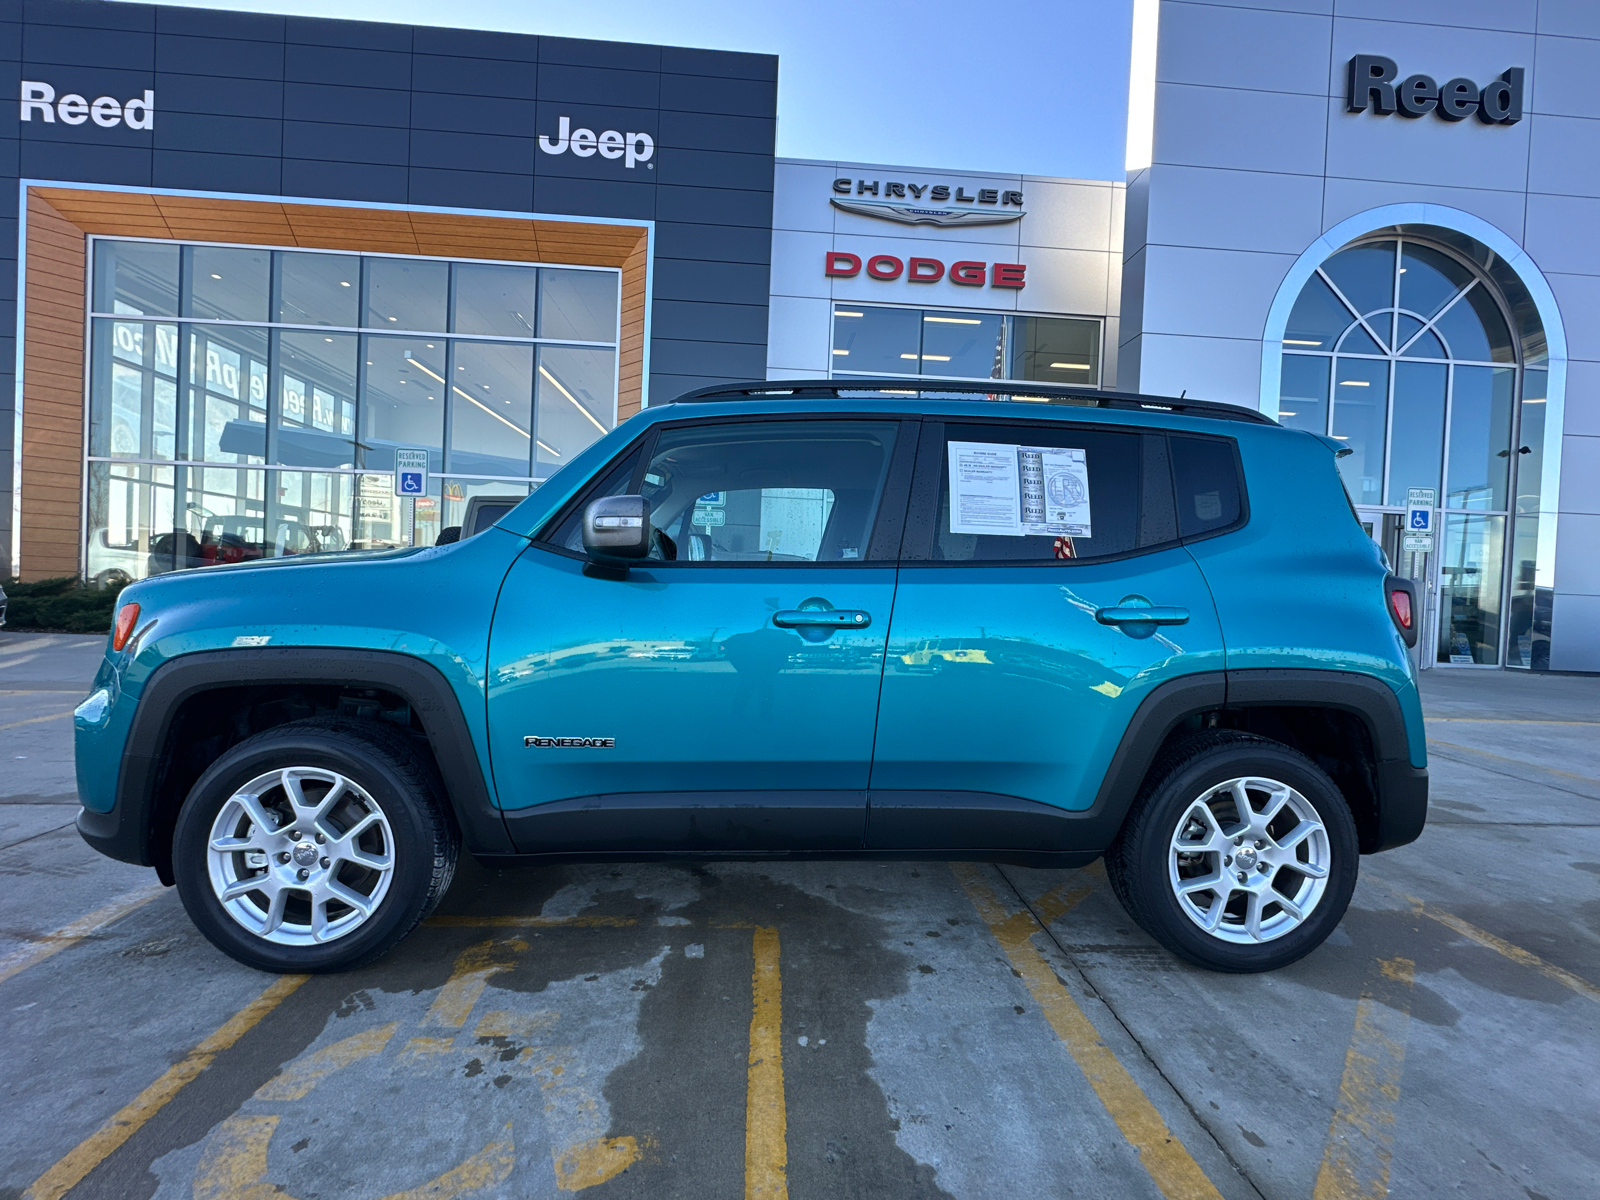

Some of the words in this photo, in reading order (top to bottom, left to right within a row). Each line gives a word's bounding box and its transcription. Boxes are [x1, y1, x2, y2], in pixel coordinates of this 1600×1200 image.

[1347, 53, 1525, 126] Reed
[20, 80, 155, 131] Reed
[539, 116, 655, 169] Jeep
[833, 178, 1024, 204] CHRYSLER
[825, 251, 1027, 290] DODGE
[398, 452, 426, 461] RESERVED
[398, 460, 426, 469] PARKING
[1024, 492, 1043, 500] REED
[1025, 506, 1044, 514] REED
